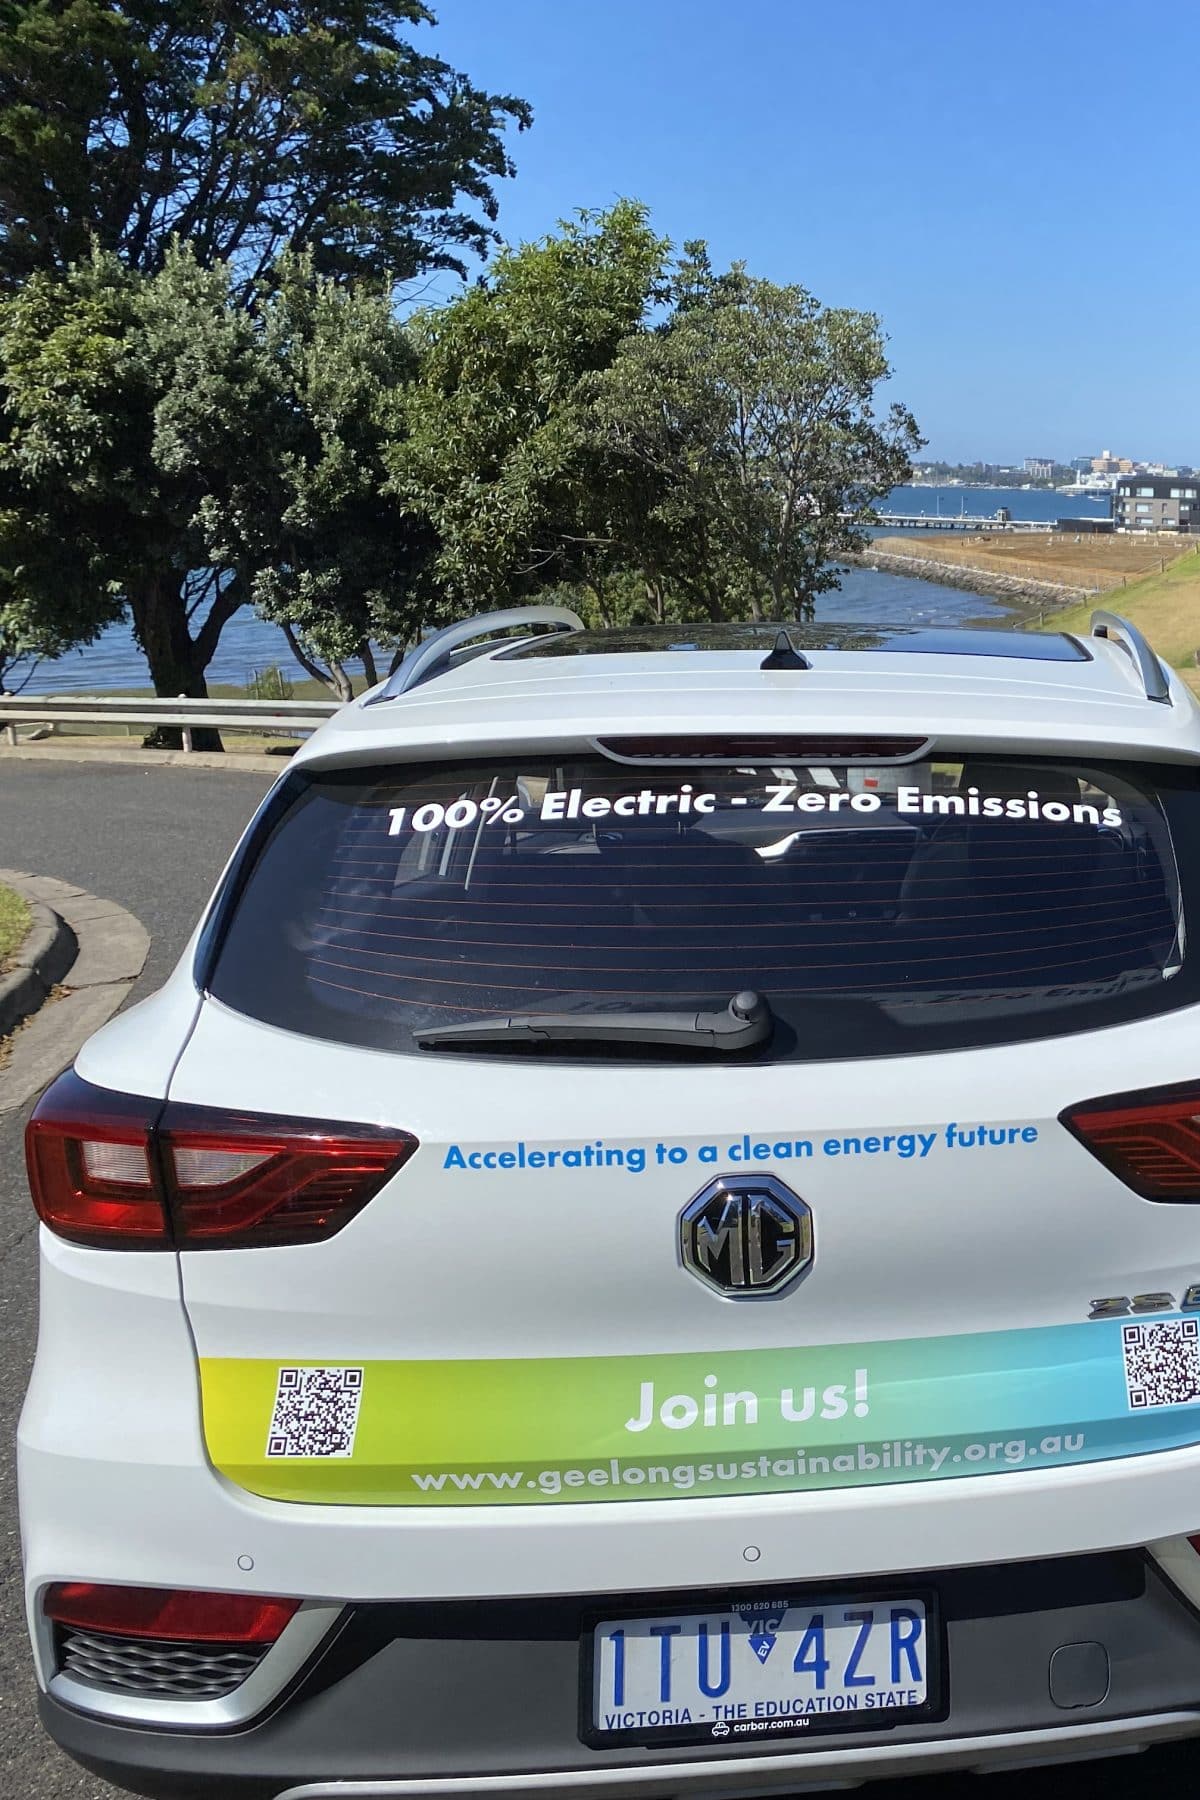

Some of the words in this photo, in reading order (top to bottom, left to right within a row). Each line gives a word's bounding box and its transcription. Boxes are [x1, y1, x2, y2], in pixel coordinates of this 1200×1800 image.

[388, 795, 525, 836] 100%
[540, 784, 716, 821] Electric
[731, 797, 747, 806] -
[761, 785, 882, 813] Zero
[897, 785, 1123, 827] Emissions
[443, 1141, 647, 1173] Accelerating
[656, 1143, 688, 1164] to
[697, 1146, 718, 1163] a
[727, 1135, 813, 1161] clean
[823, 1133, 938, 1158] energy
[945, 1123, 1039, 1147] future
[696, 1193, 796, 1286] MG
[624, 1374, 759, 1433] Join
[780, 1368, 870, 1422] us!
[410, 1433, 1085, 1495] www.geelongsustainability.org.au
[746, 1618, 781, 1636] VIC
[757, 1640, 770, 1657] EV
[608, 1621, 731, 1707] 1TU
[793, 1607, 923, 1690] 4ZR
[605, 1708, 692, 1729] VICTORIA
[712, 1703, 747, 1720] THE
[754, 1694, 858, 1717] EDUCATION
[864, 1689, 918, 1707] STATE
[733, 1718, 810, 1733] carbar.com.au
